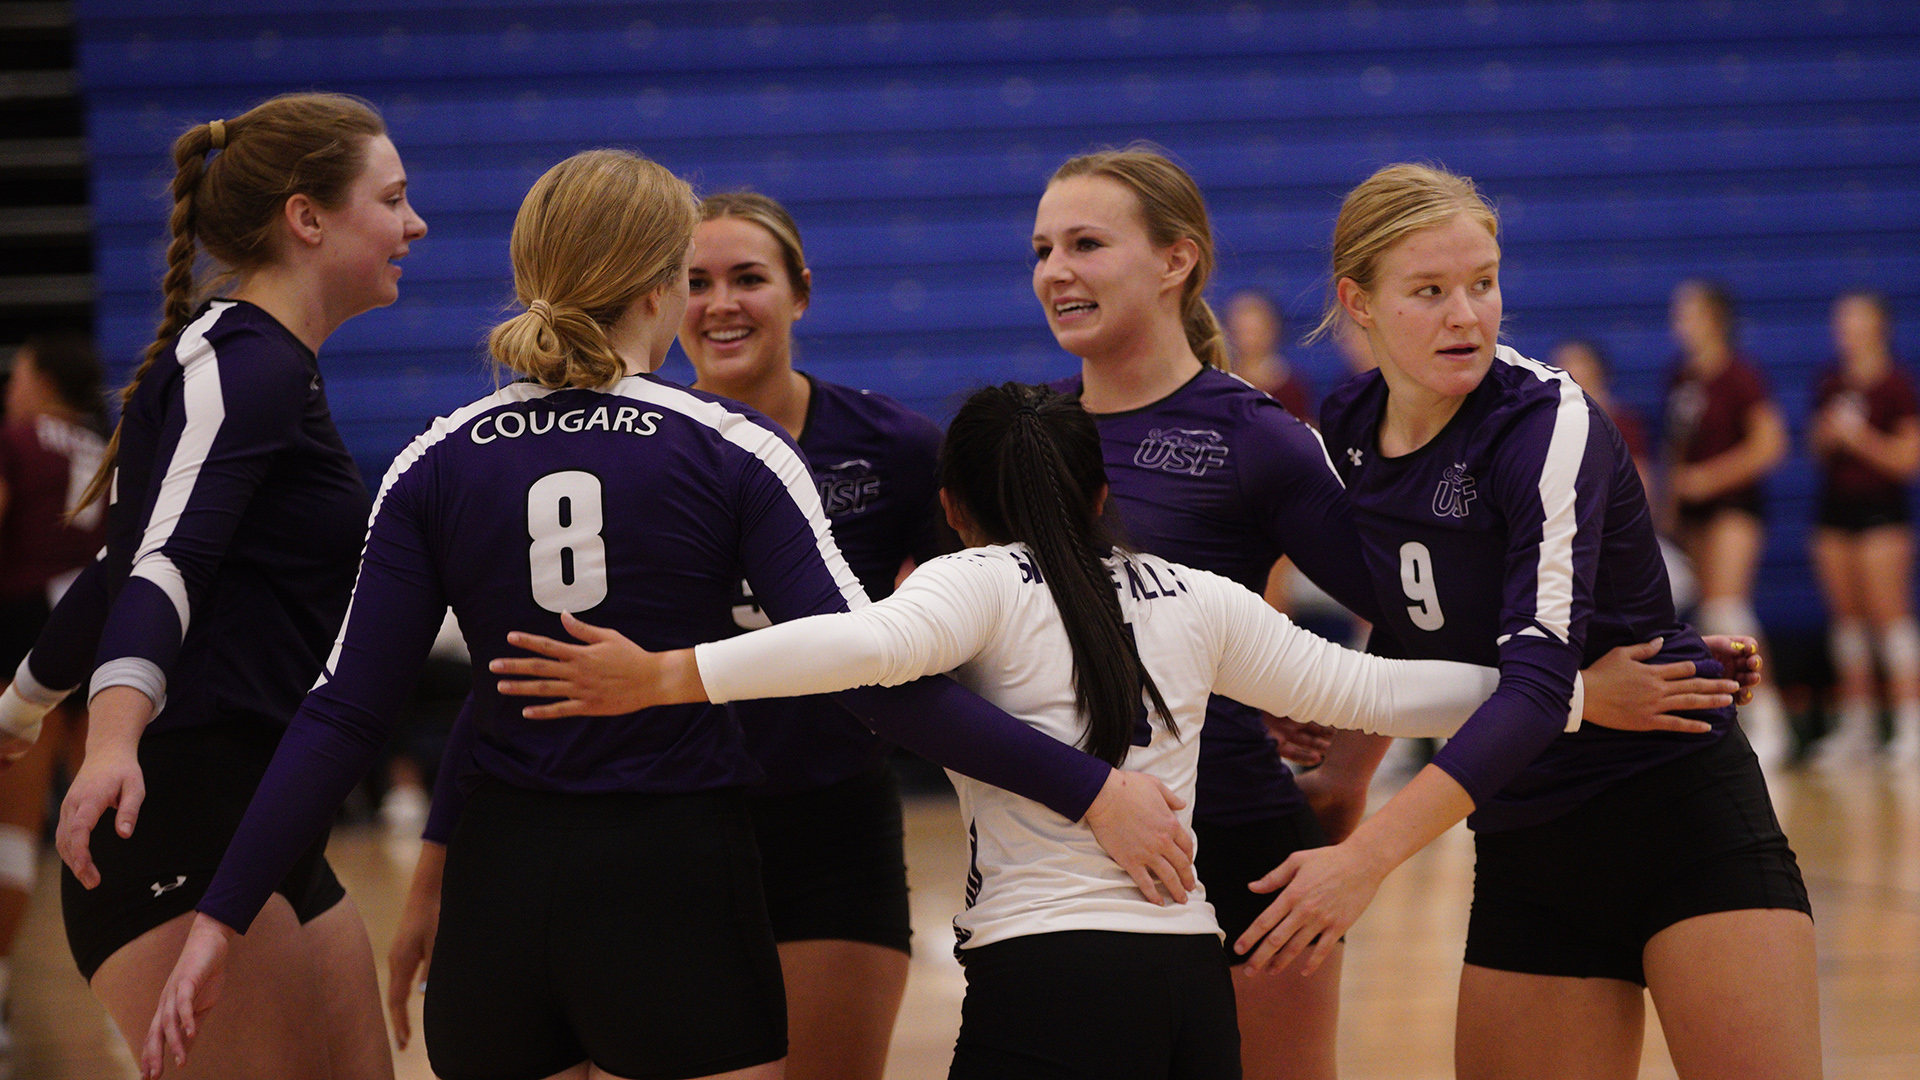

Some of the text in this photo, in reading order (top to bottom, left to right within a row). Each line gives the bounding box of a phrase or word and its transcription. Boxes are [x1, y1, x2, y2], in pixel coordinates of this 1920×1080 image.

[470, 406, 664, 445] COUGARS
[1133, 438, 1230, 477] USF
[526, 469, 609, 615] 8
[1399, 540, 1446, 633] 9
